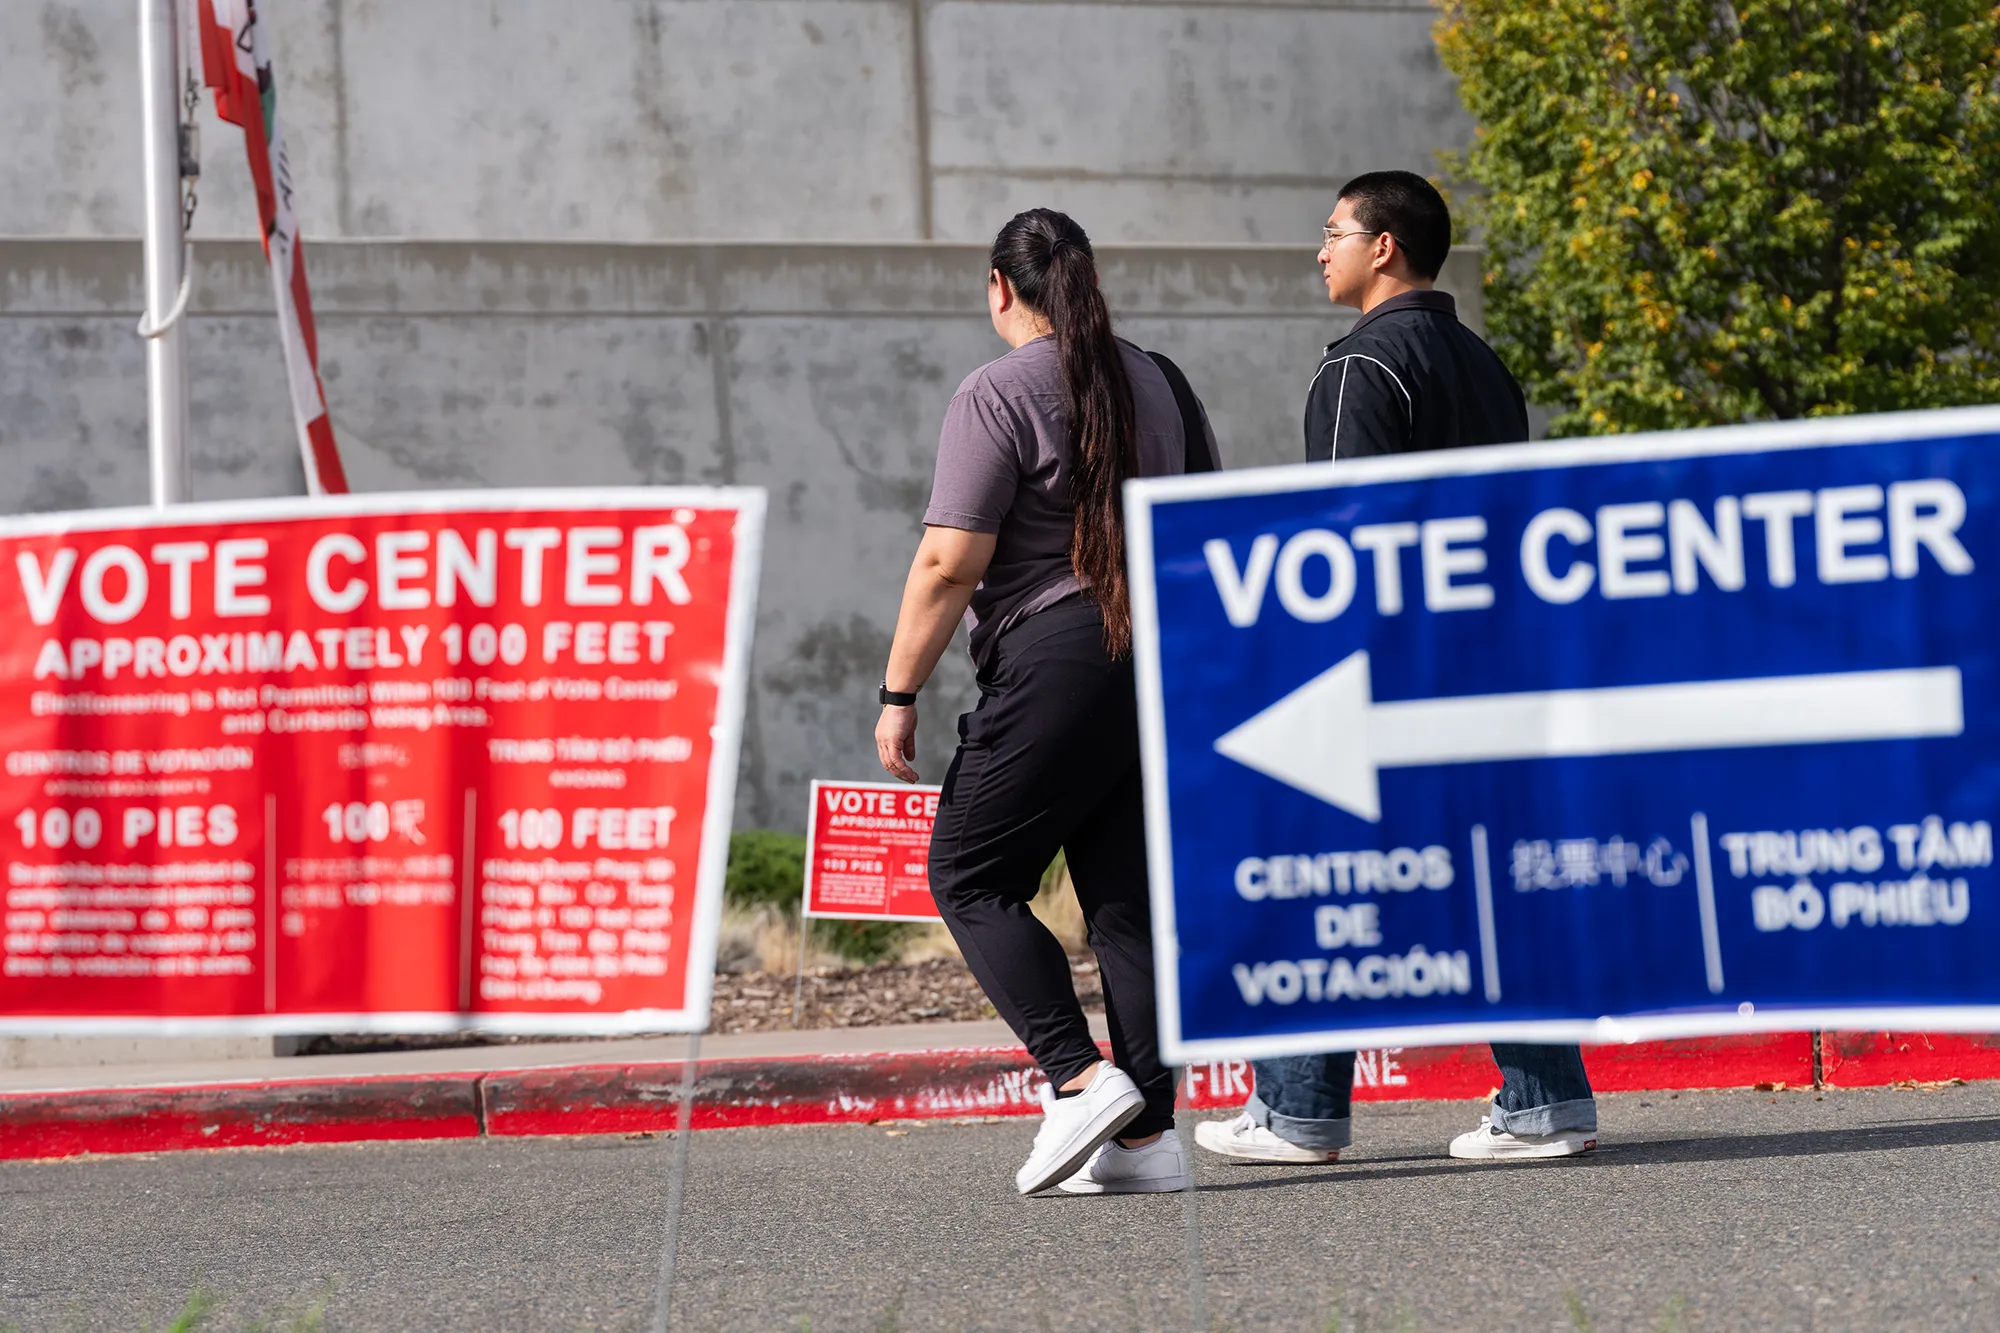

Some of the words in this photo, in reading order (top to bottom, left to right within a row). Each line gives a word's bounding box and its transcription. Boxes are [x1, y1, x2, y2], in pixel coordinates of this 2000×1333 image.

[15, 537, 271, 627] VOTE
[306, 526, 692, 614] CENTER
[1203, 515, 1495, 628] VOTE
[1519, 478, 1976, 606] CENTER
[33, 624, 430, 680] APPROXIMATELY
[440, 622, 527, 666] 100
[542, 620, 675, 665] FEET
[15, 807, 102, 849] 100
[123, 804, 239, 848] PIES
[499, 807, 563, 850] 100
[572, 806, 676, 850] FEET
[825, 791, 896, 815] VOTE
[829, 815, 935, 832] APPROXIMATEL
[1234, 845, 1455, 902] CENTROS
[1719, 825, 1885, 879] TRUNG
[1314, 902, 1383, 950] DE
[1232, 943, 1472, 1006] VOTACIÓN
[1185, 1060, 1249, 1099] FIR
[1354, 1048, 1407, 1086] NE
